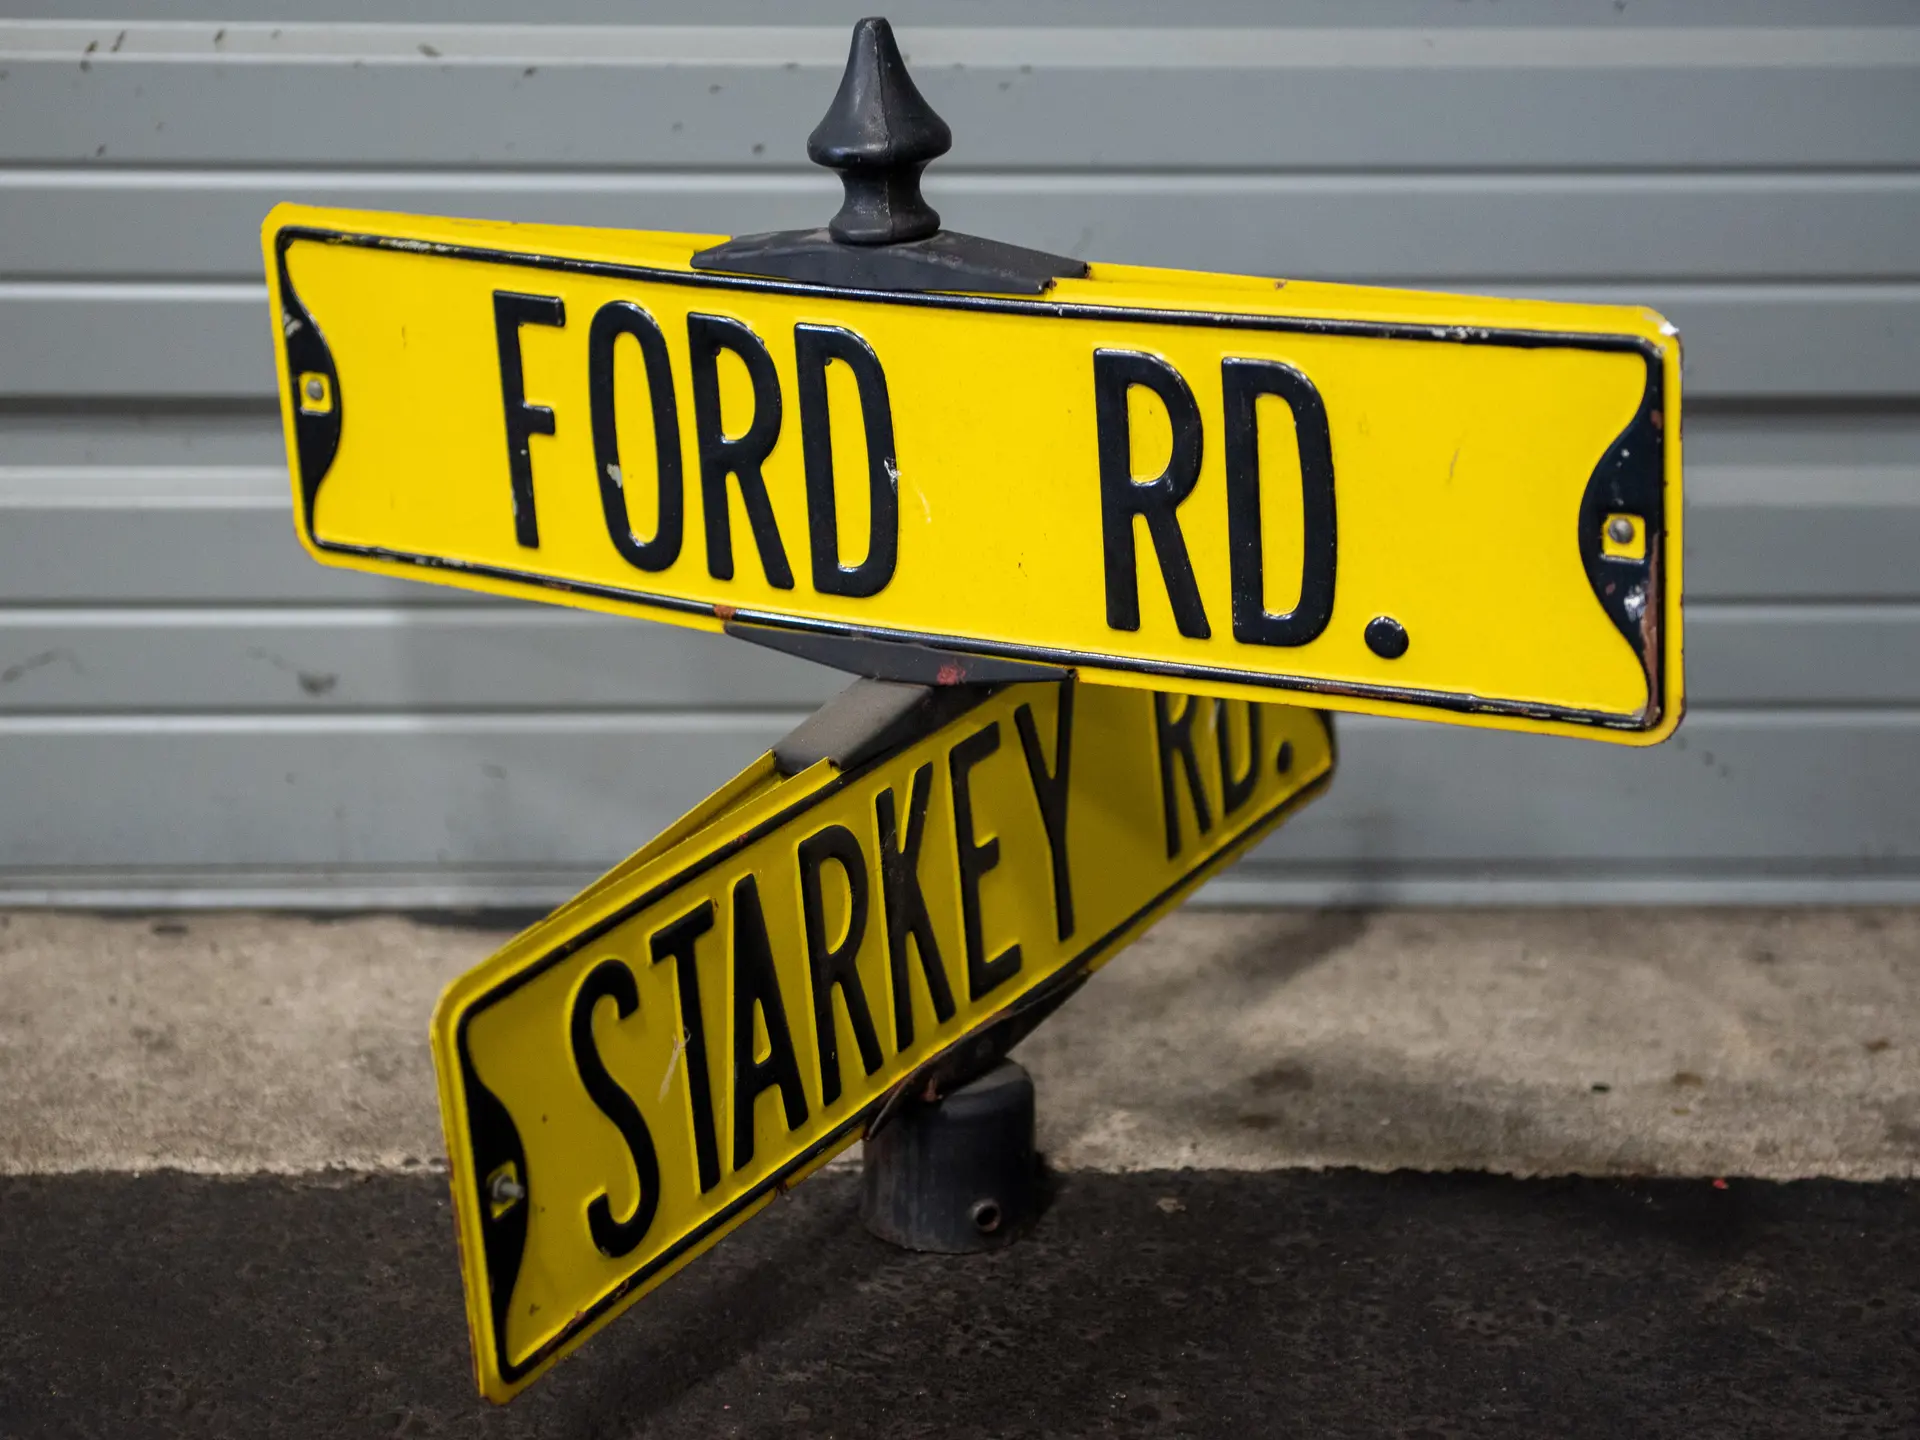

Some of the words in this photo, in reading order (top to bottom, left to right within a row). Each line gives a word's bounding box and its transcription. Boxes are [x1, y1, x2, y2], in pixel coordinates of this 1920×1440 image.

[493, 289, 899, 598] FORD
[1093, 347, 1409, 659] RD.
[570, 681, 1075, 1257] STARKEY
